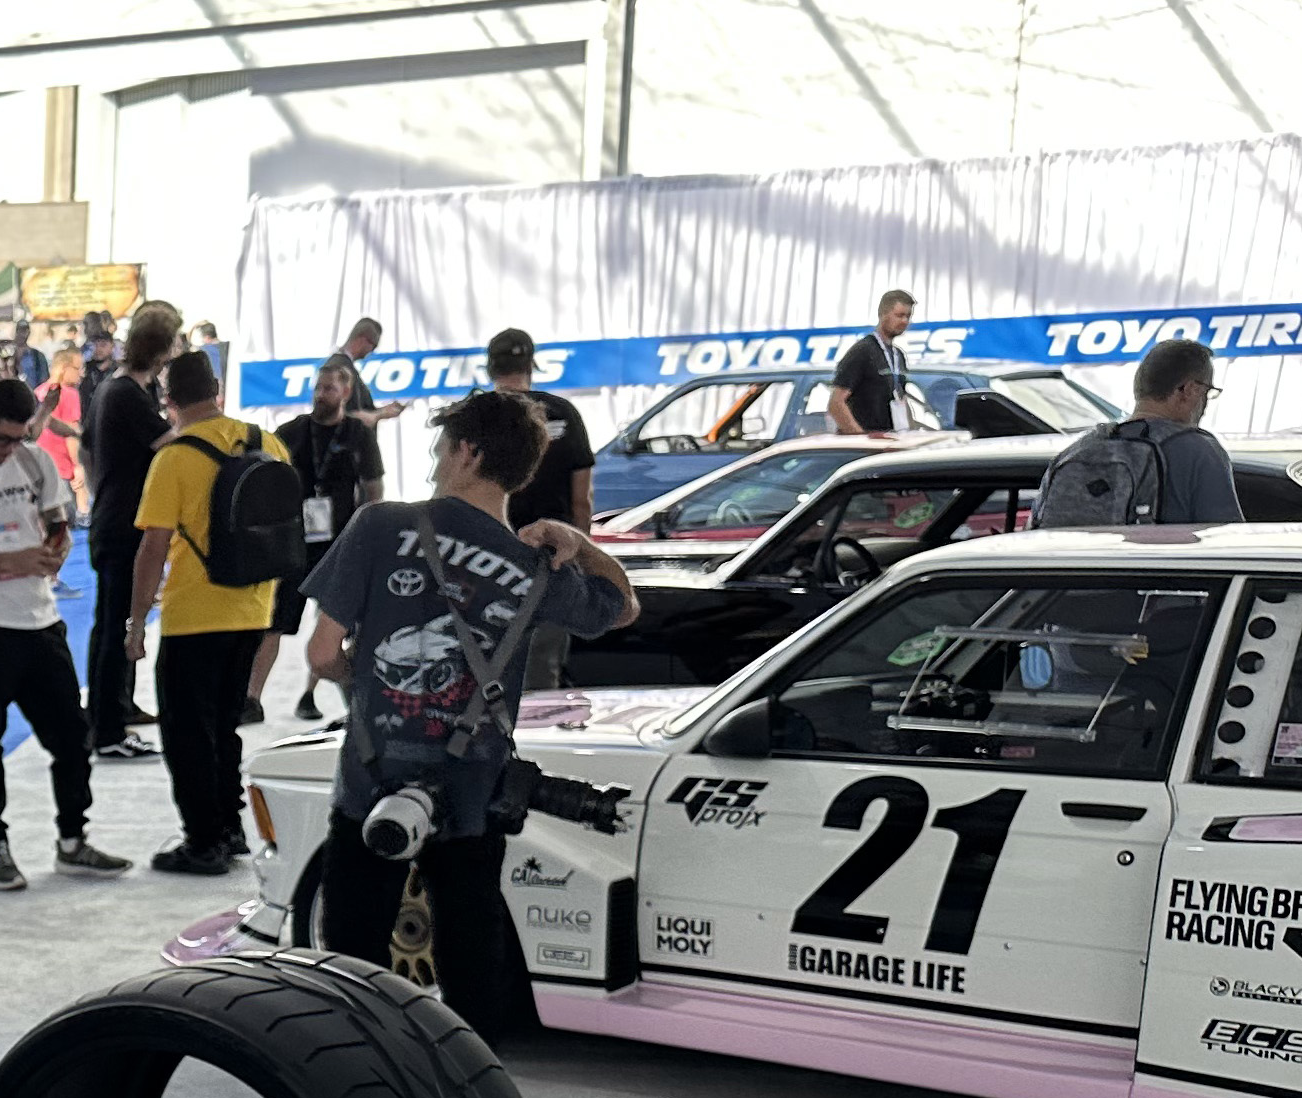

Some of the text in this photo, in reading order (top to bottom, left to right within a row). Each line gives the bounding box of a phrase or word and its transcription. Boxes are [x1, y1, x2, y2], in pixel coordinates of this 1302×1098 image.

[1047, 313, 1302, 356] TOYO TIR
[420, 349, 570, 388] TIRS
[657, 336, 801, 376] TOYO
[697, 805, 770, 830] projx
[790, 775, 1028, 956] 21
[527, 904, 592, 927] nuke
[1169, 879, 1269, 917] FLYING
[656, 916, 712, 937] LIQUI
[656, 935, 712, 956] MOLY
[1165, 911, 1276, 950] RACING
[799, 945, 906, 986] GARAGE
[912, 961, 966, 994] LIFE
